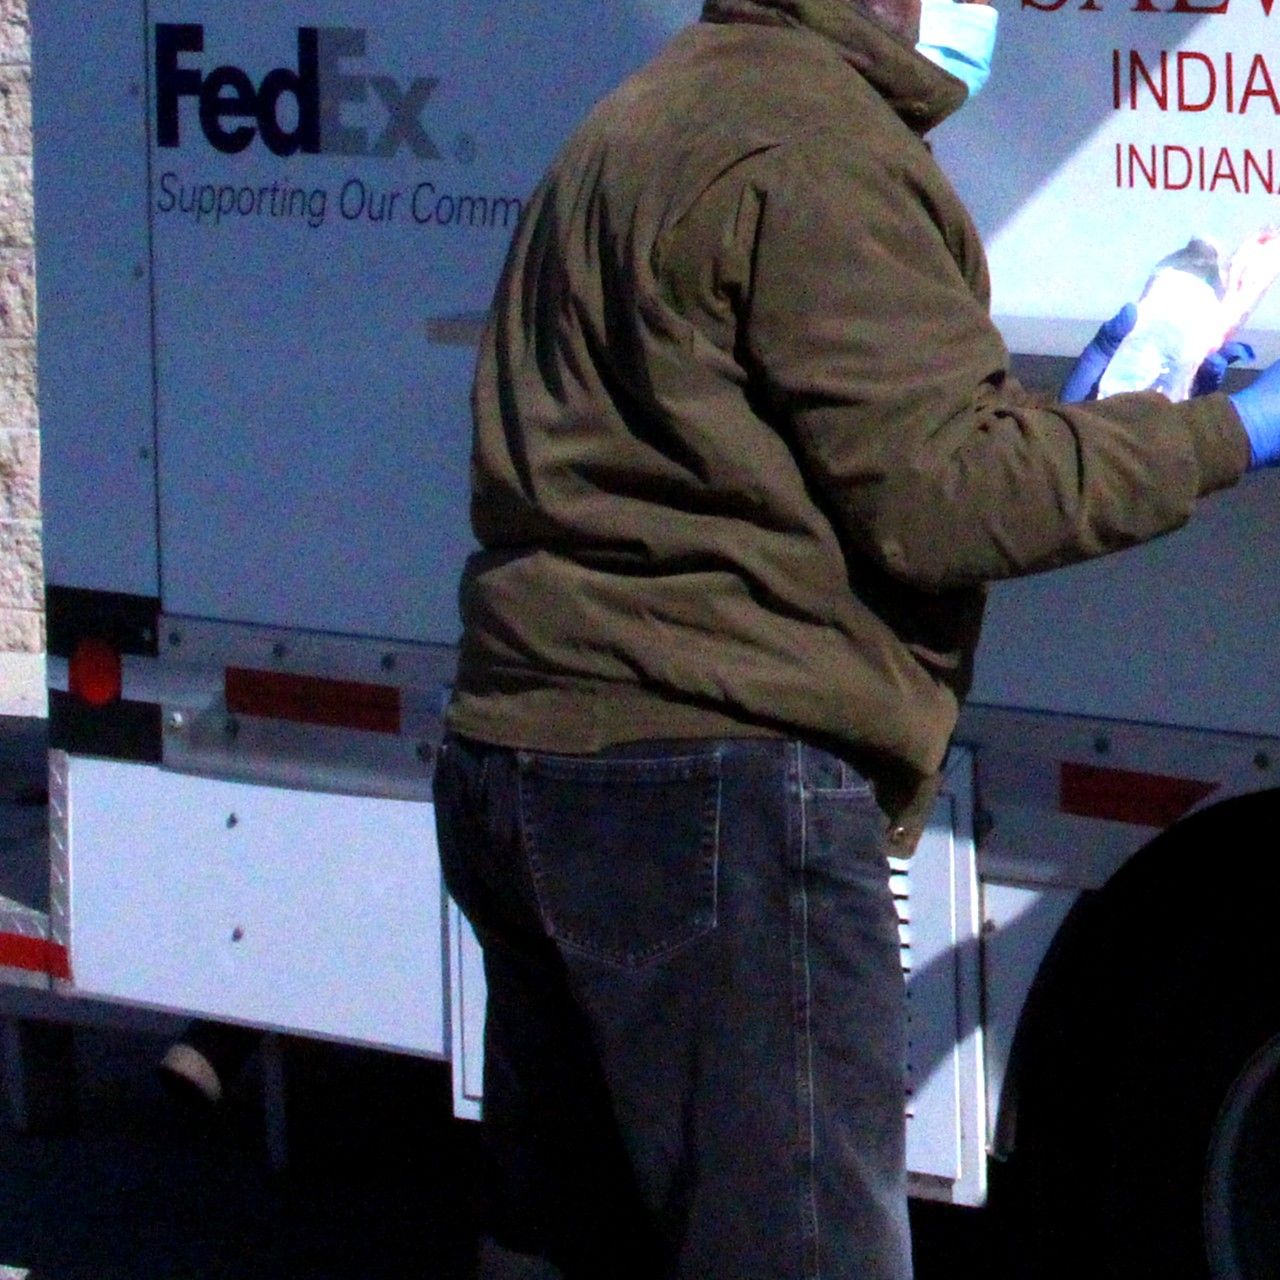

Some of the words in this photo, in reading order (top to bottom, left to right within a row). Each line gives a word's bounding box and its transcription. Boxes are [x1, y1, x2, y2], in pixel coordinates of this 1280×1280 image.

[154, 22, 442, 160] FedEx
[157, 171, 326, 228] Supporting
[341, 177, 402, 222] Our
[412, 181, 522, 227] Comm
